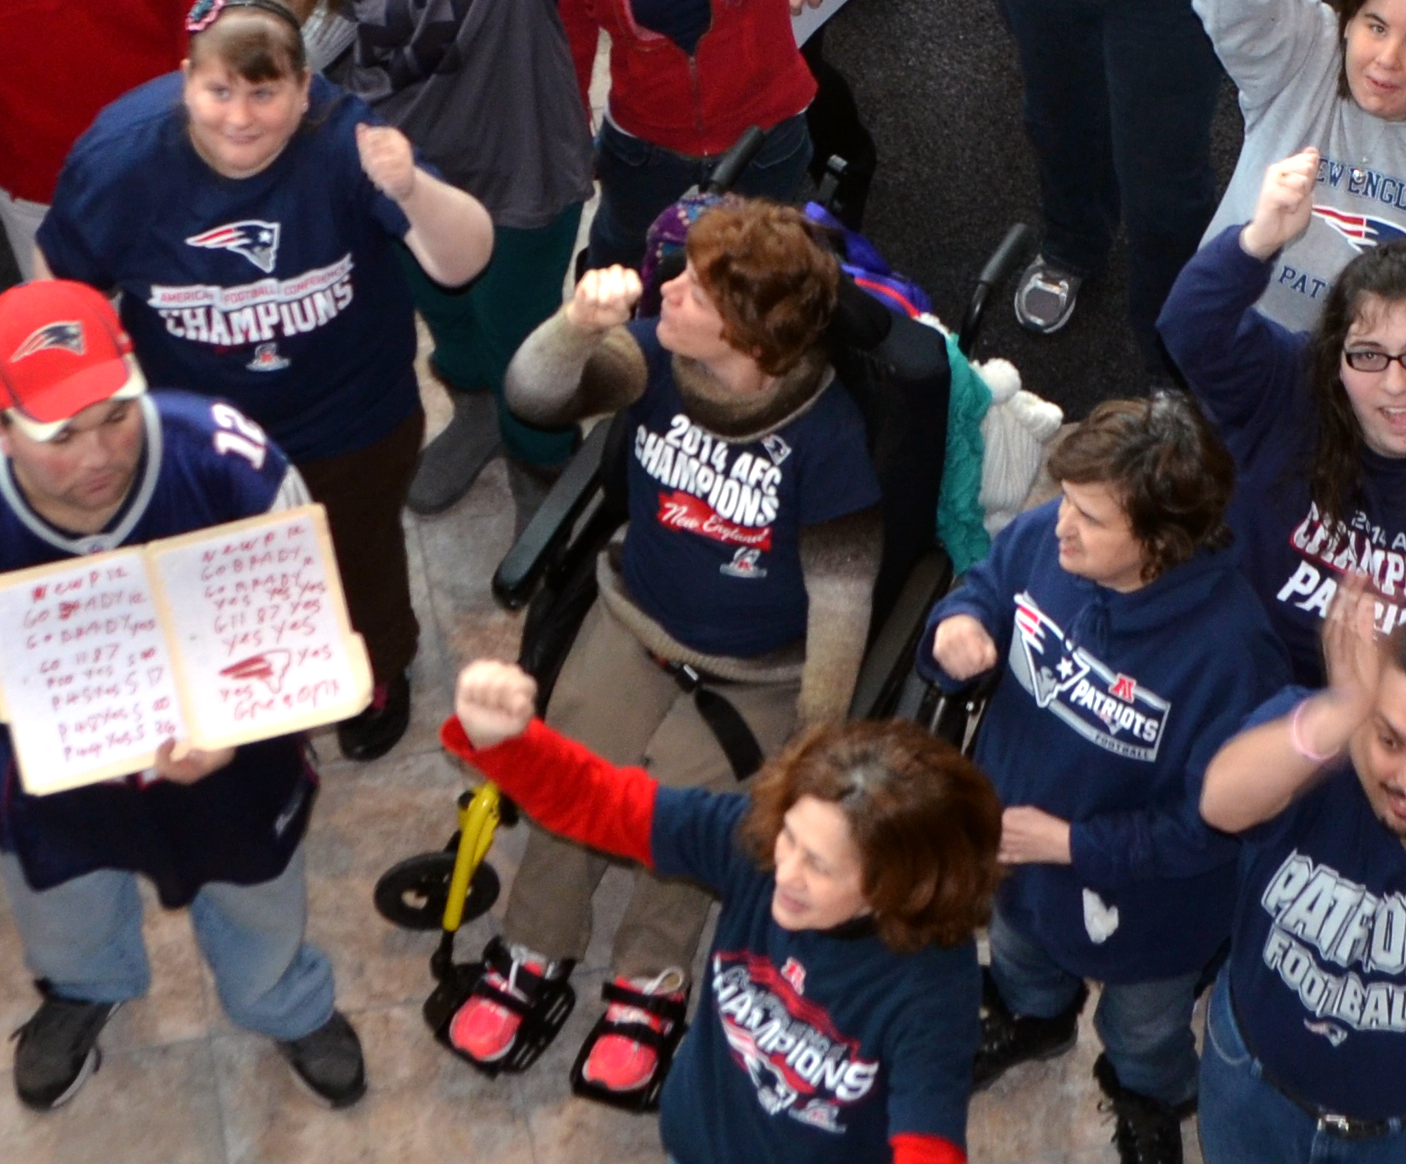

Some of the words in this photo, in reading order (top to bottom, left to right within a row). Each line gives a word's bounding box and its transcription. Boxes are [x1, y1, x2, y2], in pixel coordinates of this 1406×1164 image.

[1315, 157, 1345, 187] EW
[211, 402, 268, 470] 12
[665, 413, 729, 473] 2014
[730, 451, 783, 497] AFC
[635, 424, 780, 527] CHAMPIONS
[661, 501, 700, 528] New
[702, 512, 771, 542] England
[1069, 677, 1160, 743] PATRIOTS
